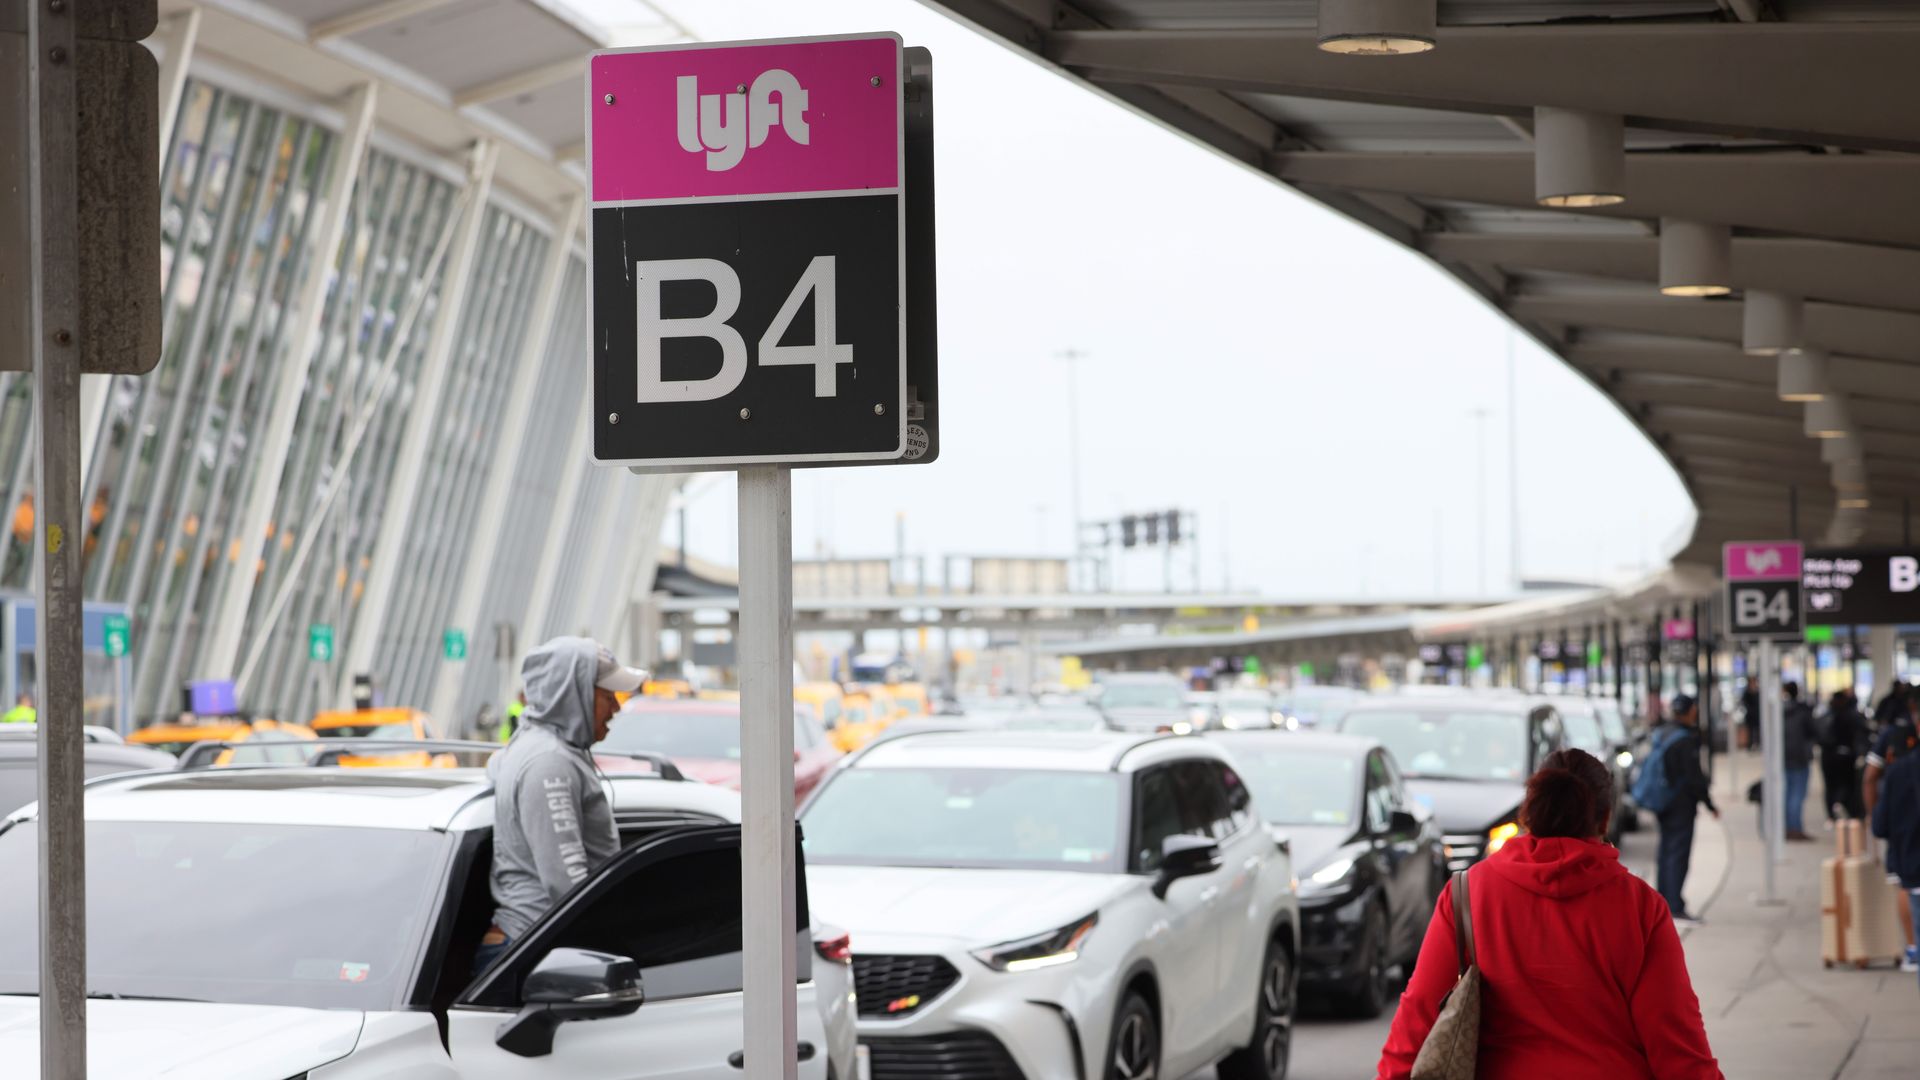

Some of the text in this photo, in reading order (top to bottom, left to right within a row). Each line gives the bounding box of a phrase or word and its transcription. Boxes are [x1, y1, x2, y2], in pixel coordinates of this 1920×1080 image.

[676, 69, 810, 172] lyft
[636, 255, 854, 403] B4
[906, 438, 927, 449] IENDS
[1888, 555, 1920, 592] B
[1735, 588, 1792, 626] B4
